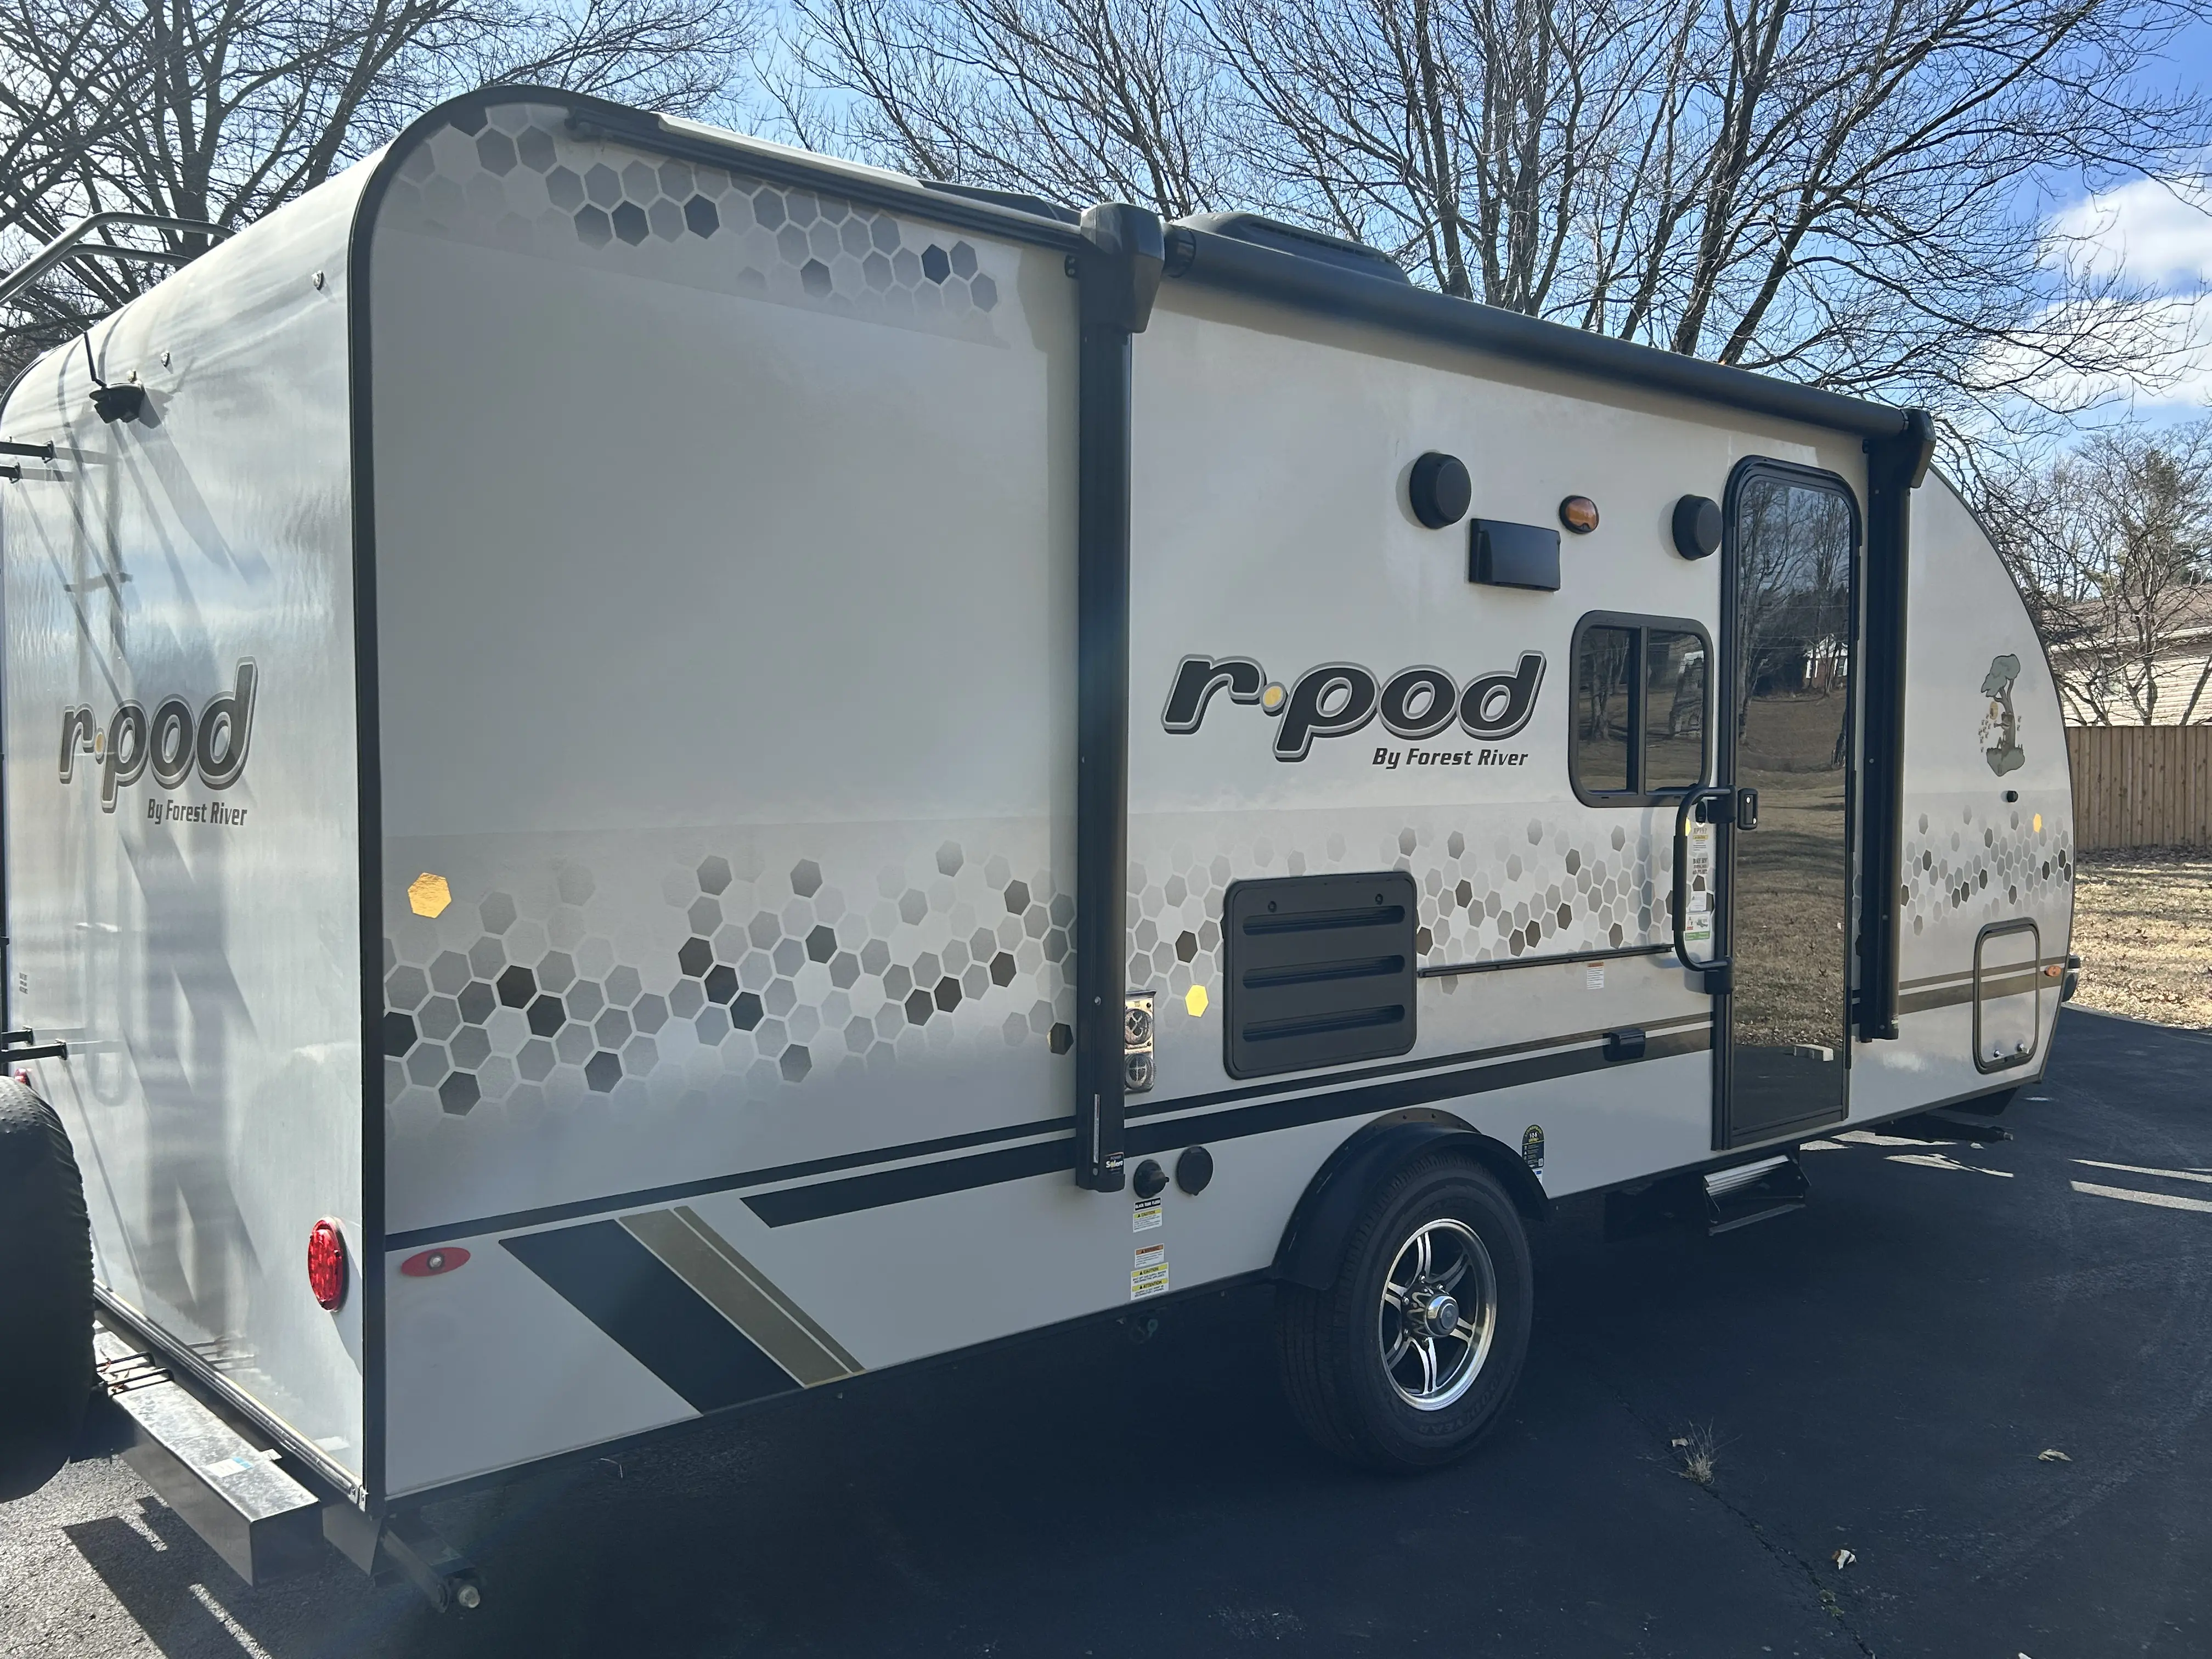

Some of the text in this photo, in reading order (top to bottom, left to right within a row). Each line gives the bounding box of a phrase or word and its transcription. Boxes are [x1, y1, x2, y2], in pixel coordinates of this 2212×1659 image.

[1372, 748, 1528, 769] By Forest River
[148, 798, 247, 826] By Forest River
